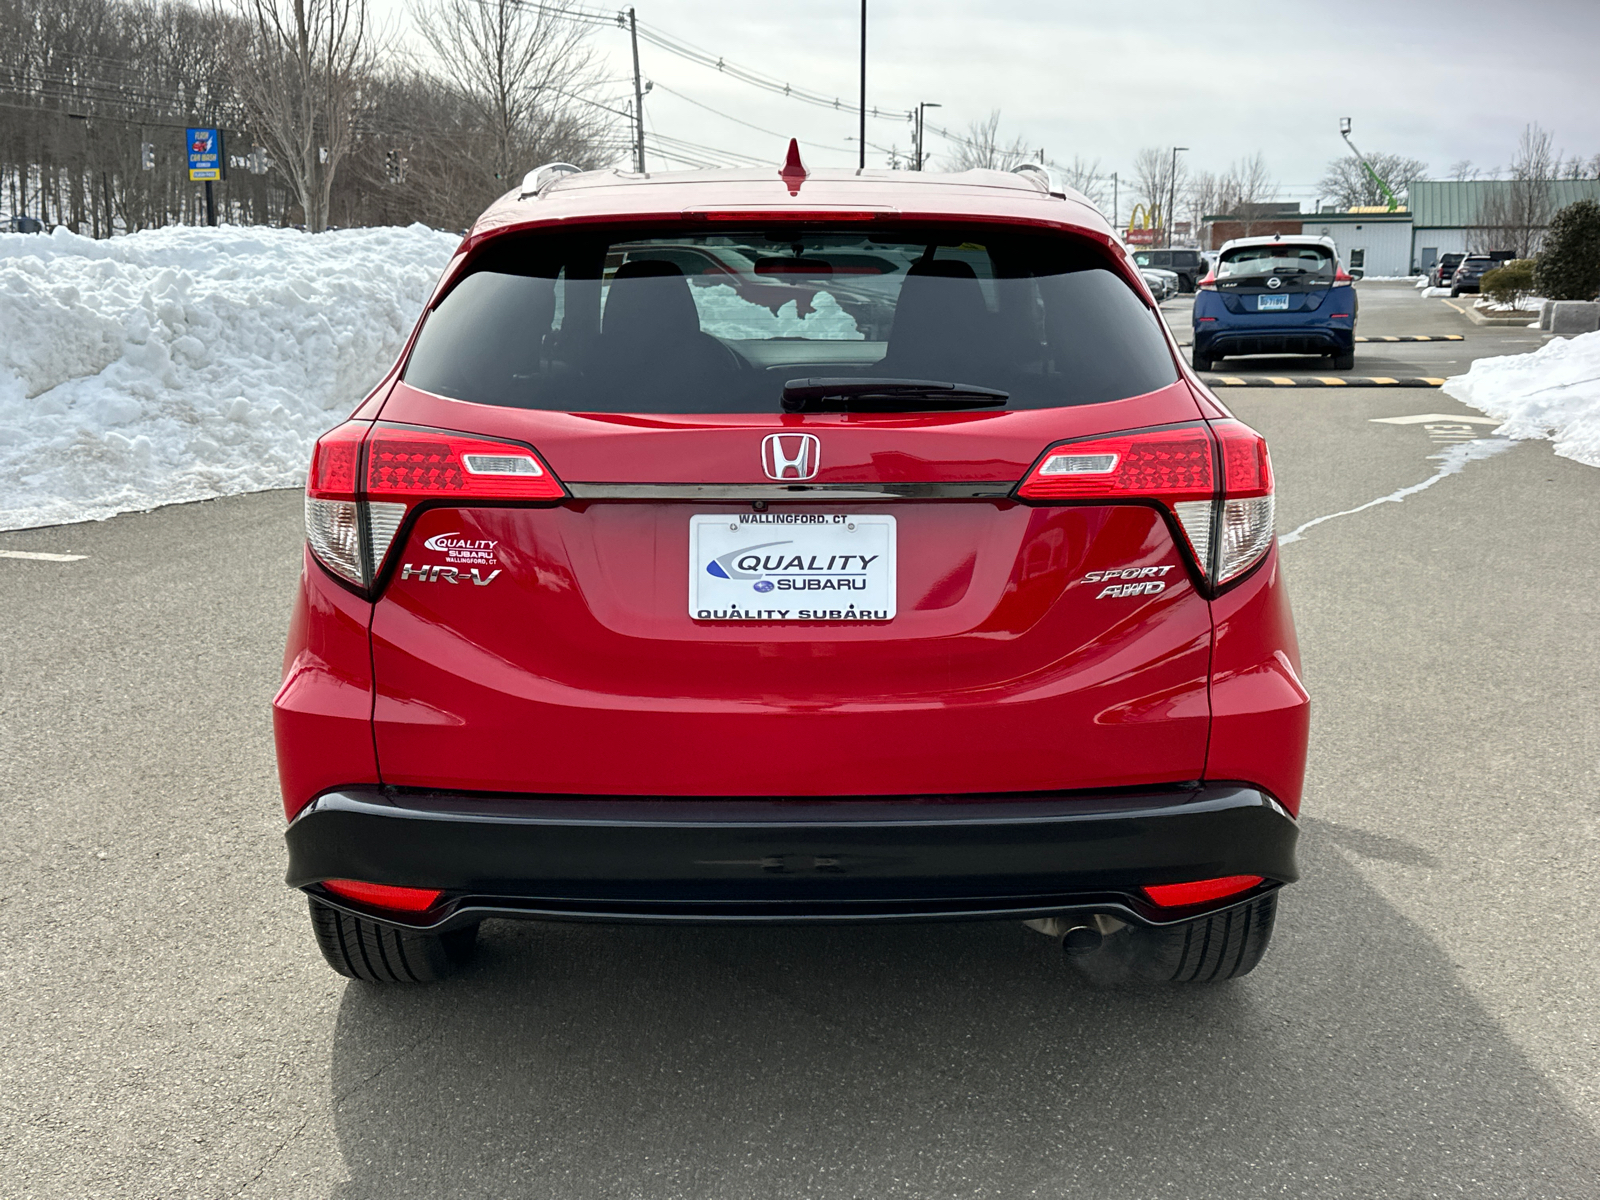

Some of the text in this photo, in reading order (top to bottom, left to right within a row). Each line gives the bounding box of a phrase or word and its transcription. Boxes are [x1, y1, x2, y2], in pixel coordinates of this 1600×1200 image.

[739, 514, 848, 524] WALLINGFORD, CT
[436, 538, 498, 549] QUALITY
[448, 550, 494, 559] SUBARU
[445, 557, 488, 565] WALLINGFORD,
[737, 555, 879, 571] QUALITY
[401, 563, 502, 586] HR-V
[1080, 564, 1176, 584] SPORT
[777, 578, 866, 591] SUBARU
[1095, 581, 1166, 600] AWD
[697, 609, 888, 619] QUALITY SUBARU
